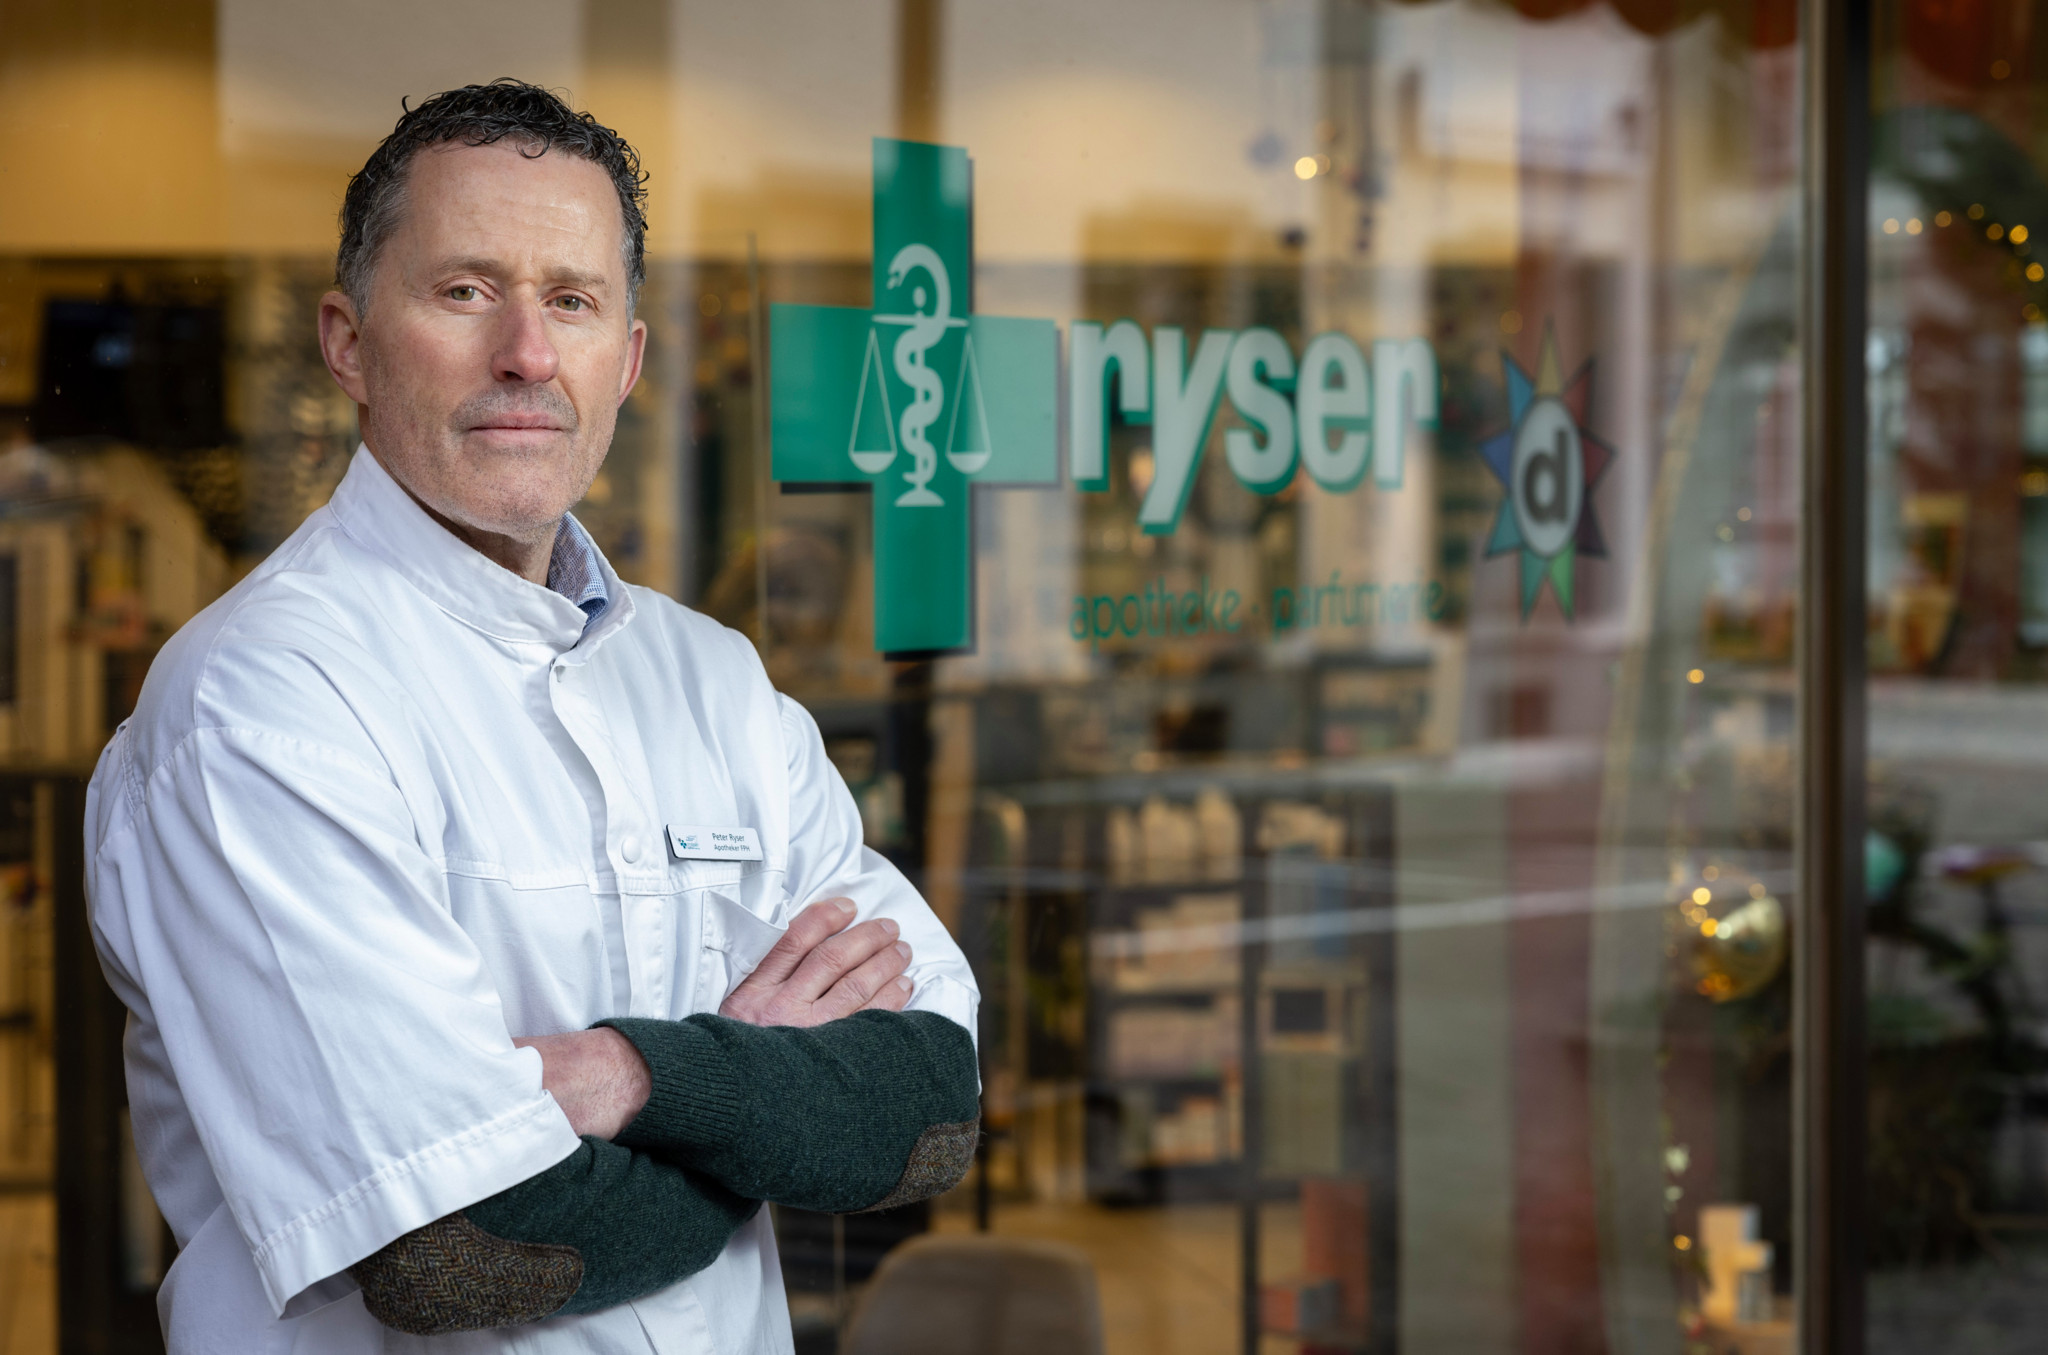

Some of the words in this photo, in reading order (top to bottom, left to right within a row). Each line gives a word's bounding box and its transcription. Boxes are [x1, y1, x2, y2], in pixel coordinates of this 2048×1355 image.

[1070, 318, 1439, 535] ryser
[1523, 428, 1569, 524] d
[1069, 575, 1242, 656] apotheke
[712, 833, 728, 841] Peter
[729, 833, 745, 844] Ryser
[714, 844, 740, 852] Apotheker
